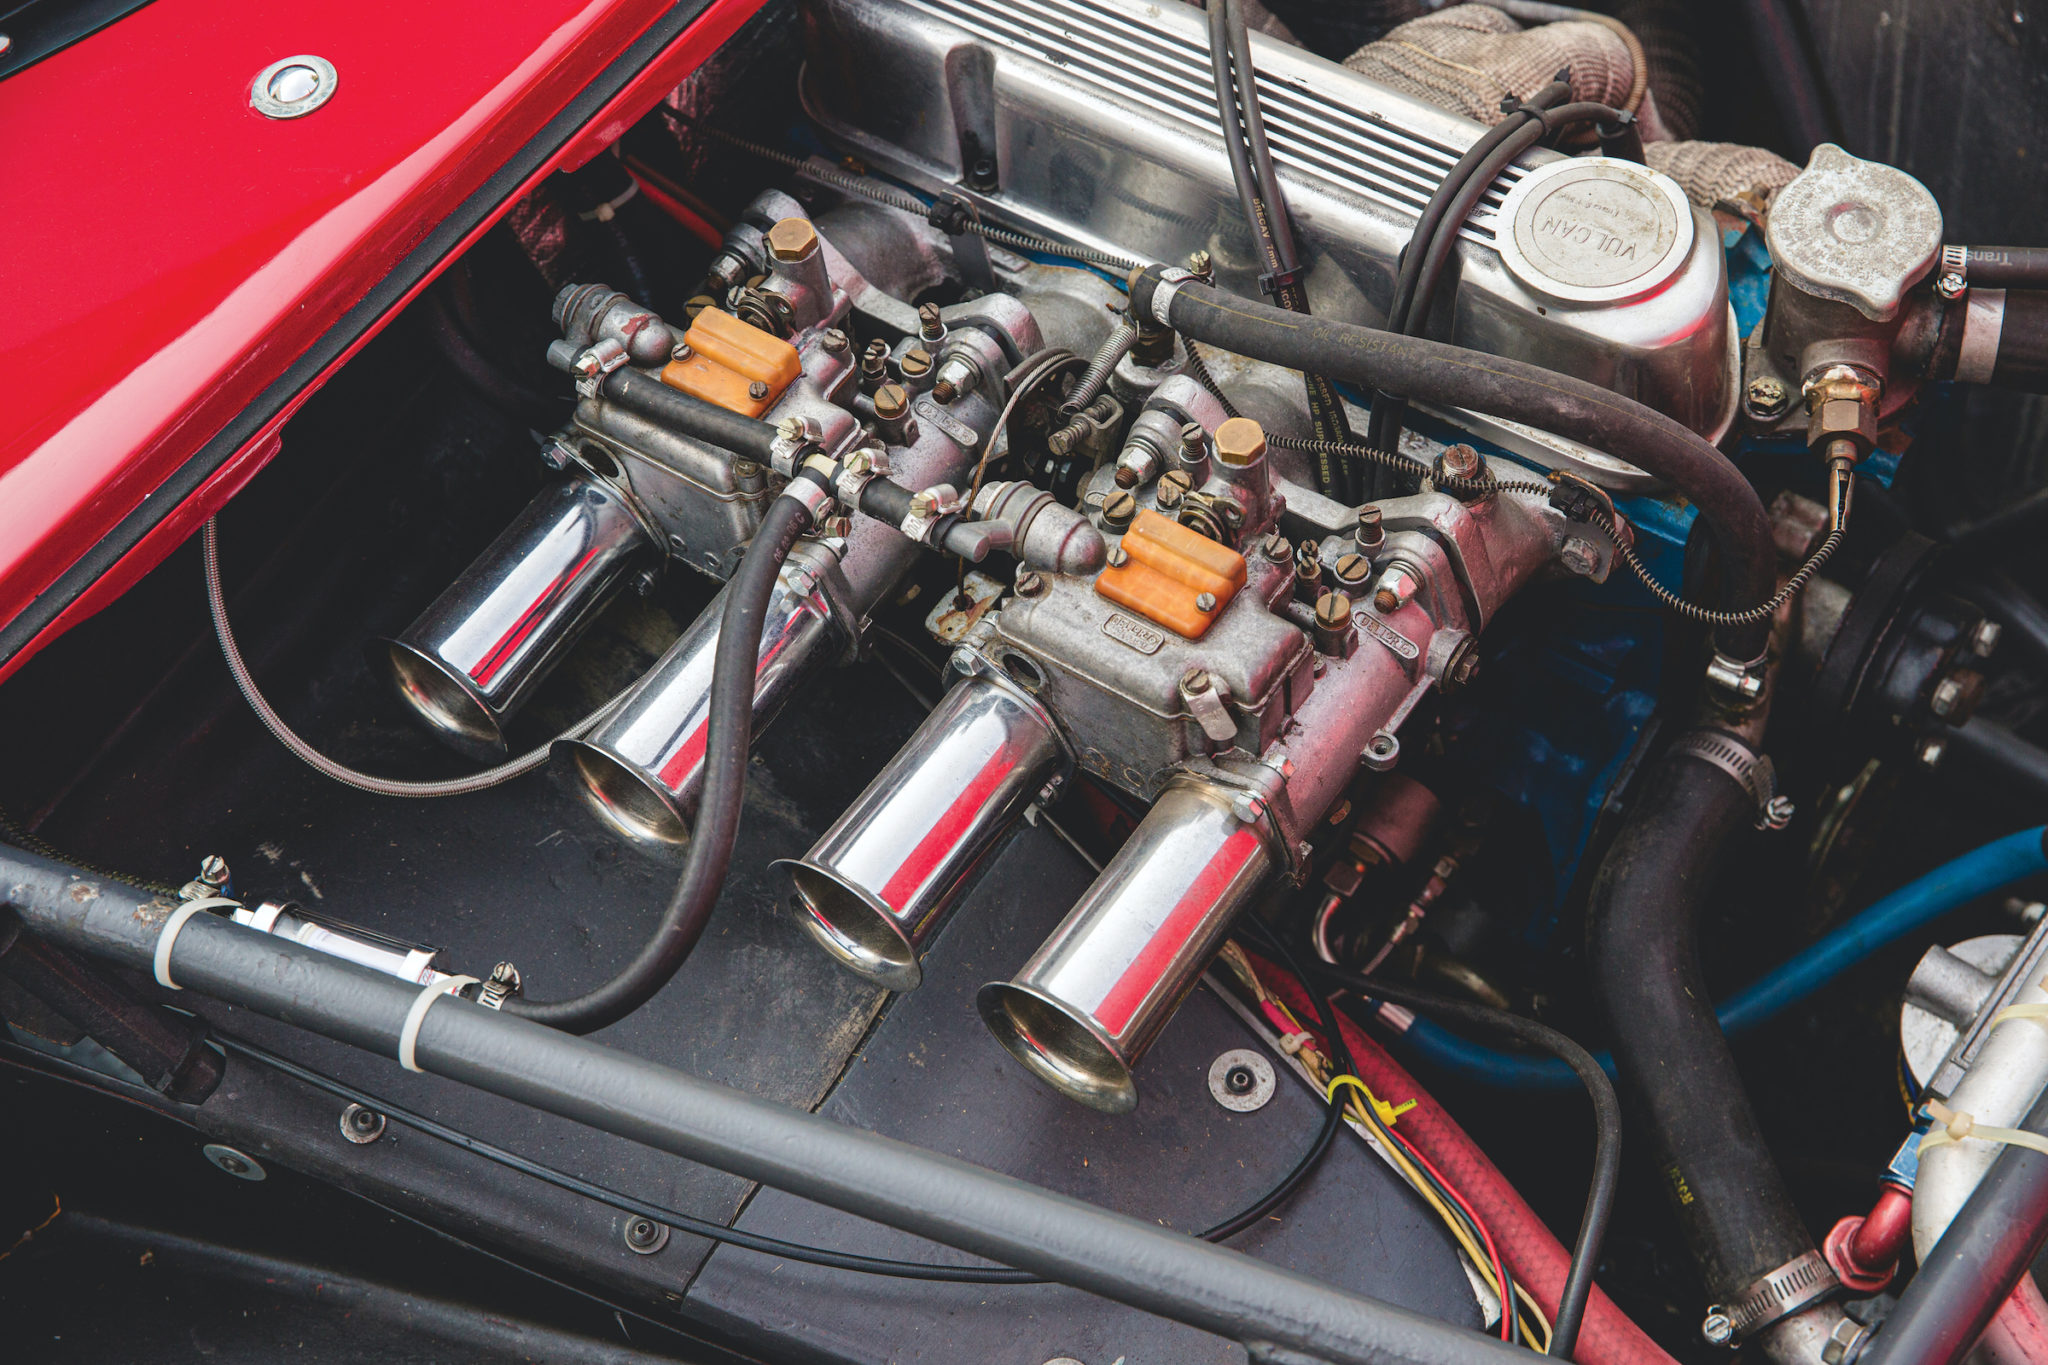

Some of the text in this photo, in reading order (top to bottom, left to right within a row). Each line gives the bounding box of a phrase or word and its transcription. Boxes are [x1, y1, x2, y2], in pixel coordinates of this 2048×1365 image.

[1541, 215, 1637, 260] VULCAN
[1312, 327, 1330, 342] OIL
[1311, 402, 1320, 415] HP
